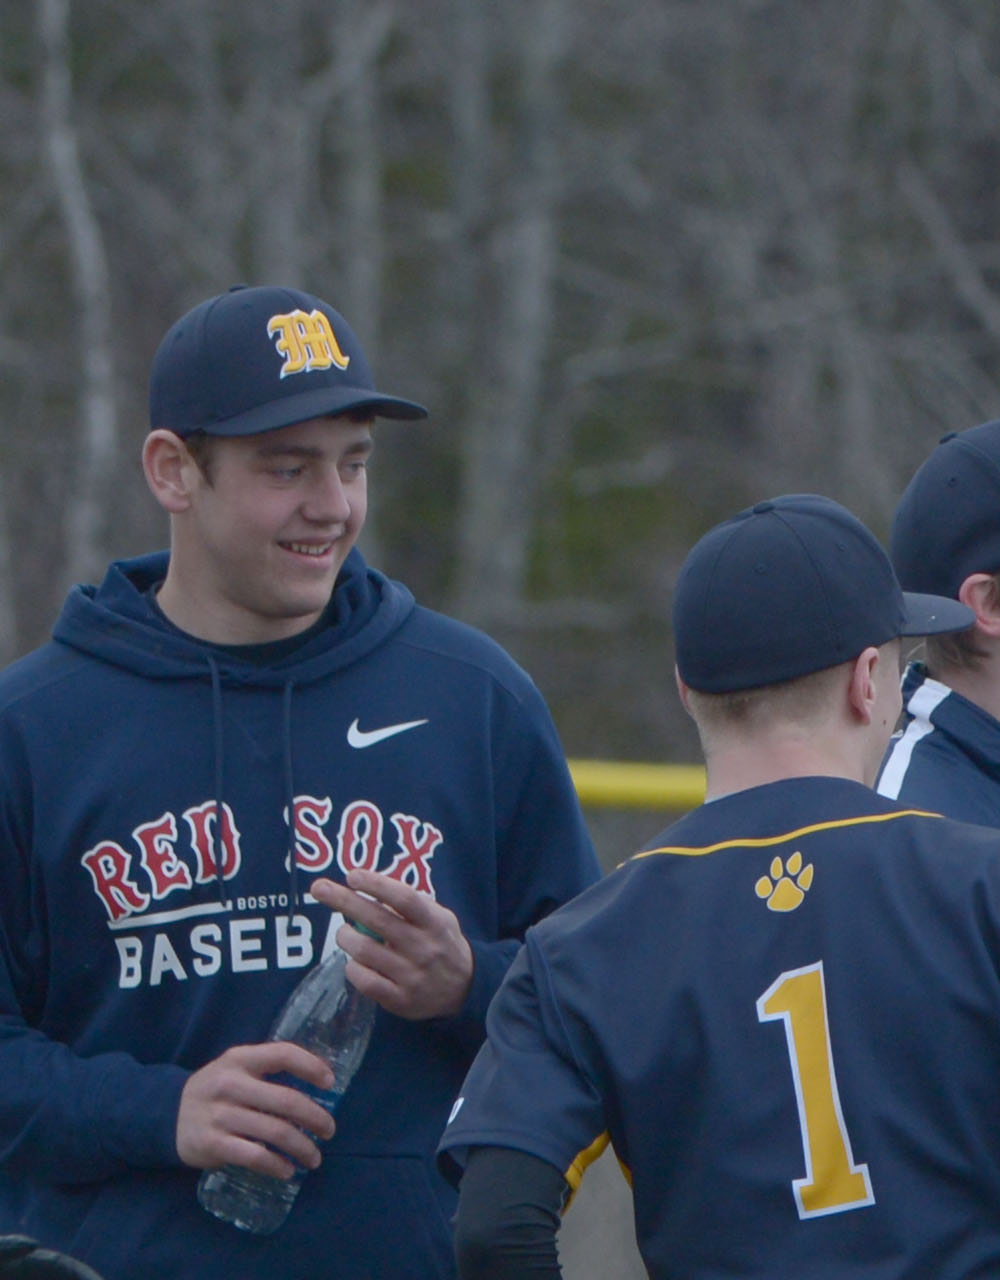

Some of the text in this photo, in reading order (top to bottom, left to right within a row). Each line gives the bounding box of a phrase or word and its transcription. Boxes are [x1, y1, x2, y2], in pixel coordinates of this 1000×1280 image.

[267, 309, 350, 379] M
[81, 795, 443, 924] RED SOX
[756, 960, 875, 1220] 1
